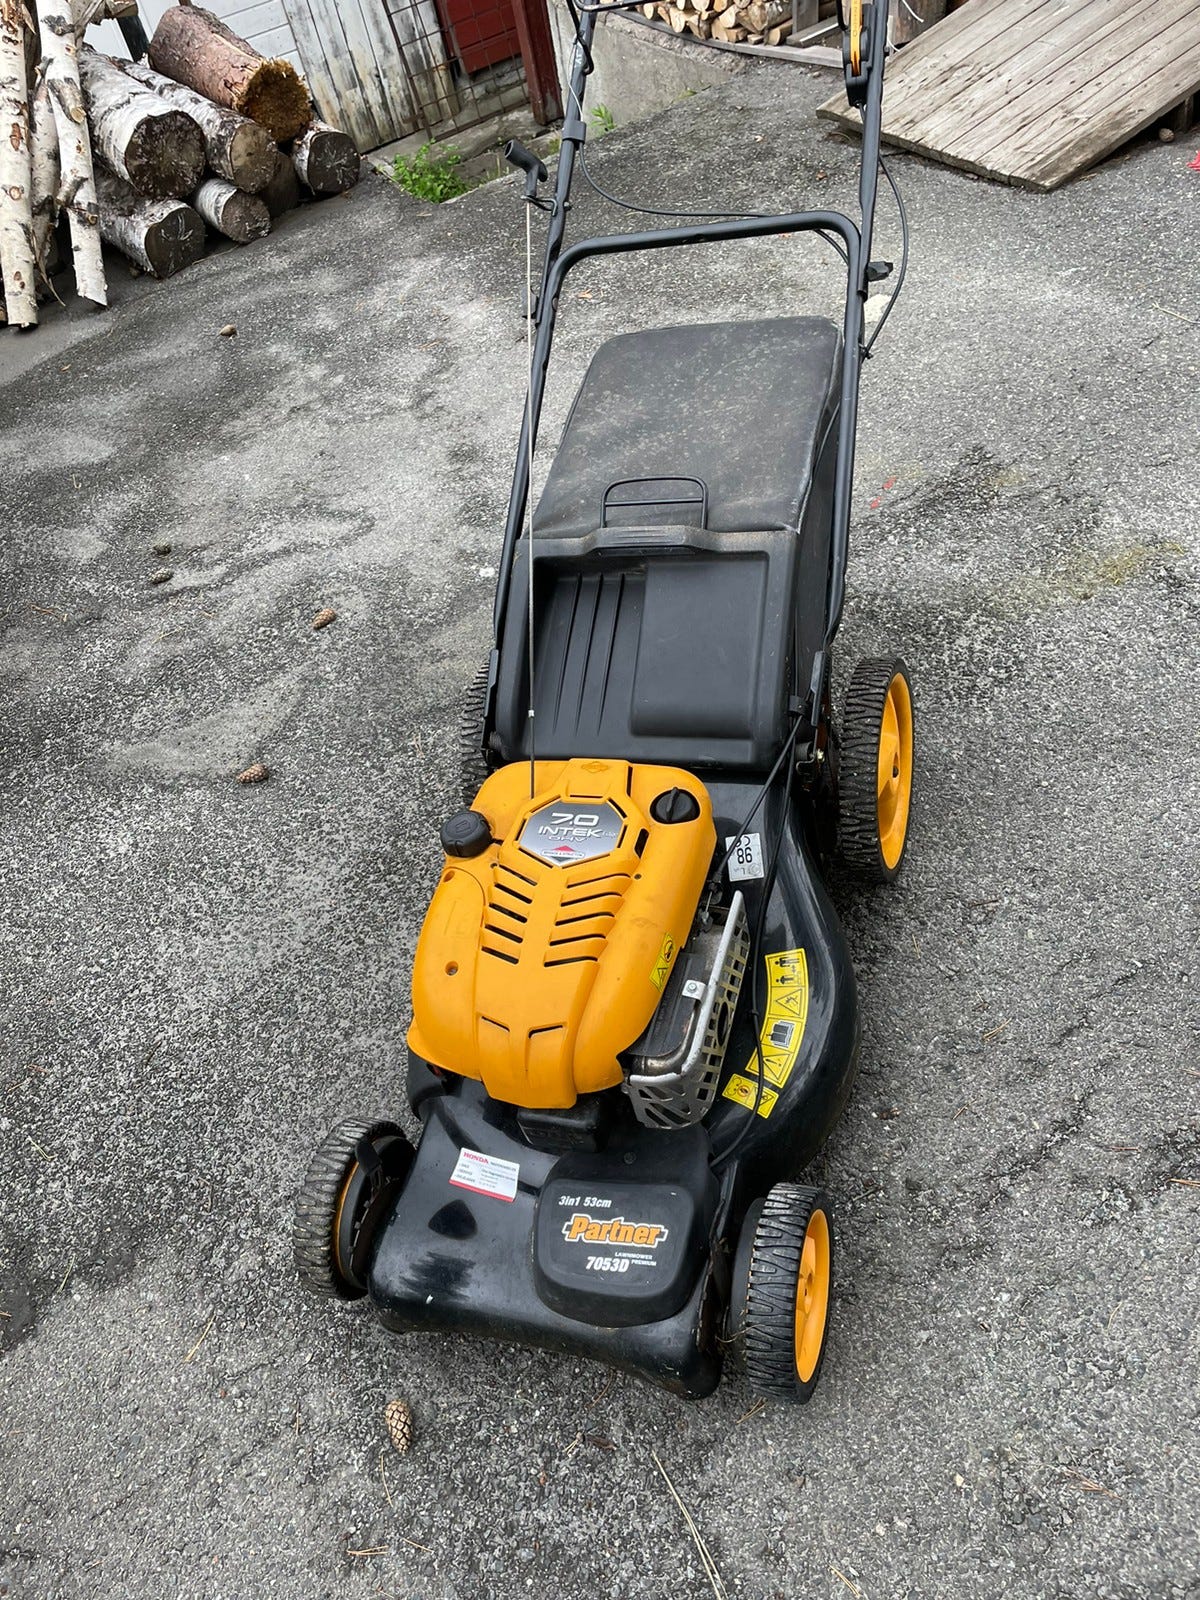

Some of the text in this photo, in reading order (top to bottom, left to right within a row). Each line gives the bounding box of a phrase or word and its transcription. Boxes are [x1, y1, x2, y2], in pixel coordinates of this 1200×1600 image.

[551, 812, 600, 827] 7.0
[538, 826, 602, 838] INTEK
[463, 1151, 489, 1164] HONDA
[558, 1195, 612, 1208] 3in1 53cm
[566, 1214, 662, 1247] Partner
[614, 1251, 653, 1260] LAWNMOWER
[585, 1256, 657, 1273] 7053D PREMIUM
